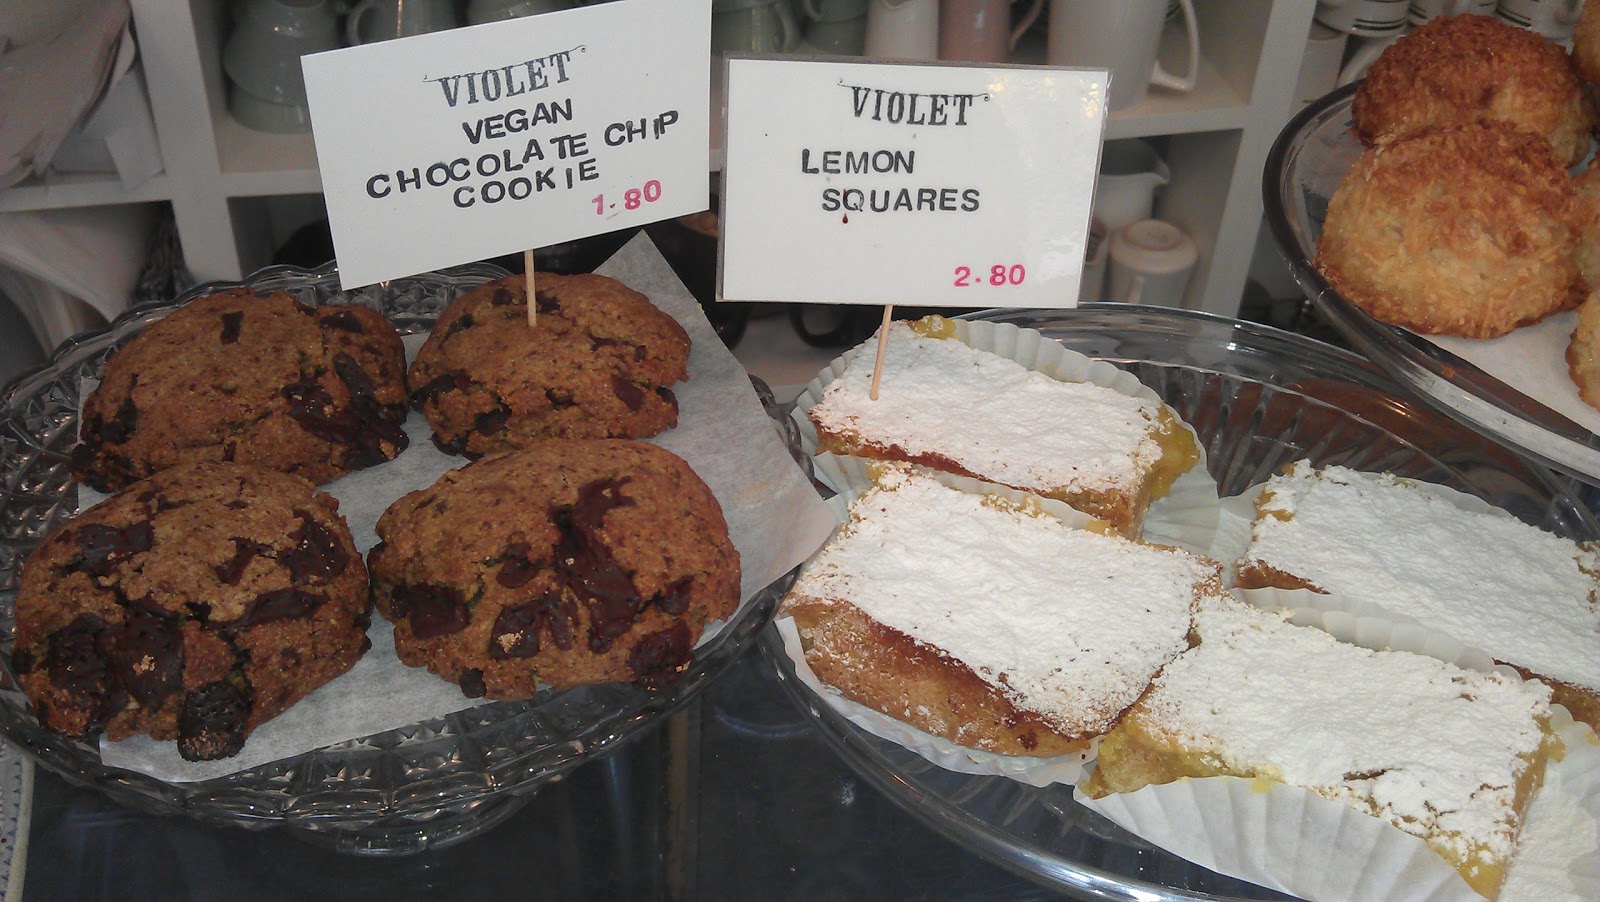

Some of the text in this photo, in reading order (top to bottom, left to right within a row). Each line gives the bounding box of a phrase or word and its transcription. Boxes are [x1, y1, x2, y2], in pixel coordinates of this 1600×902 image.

[438, 50, 572, 107] VIOLET
[462, 98, 573, 144] VEGAN
[850, 86, 973, 126] VIOLET
[366, 110, 680, 198] CHOCOLATE CHIP
[801, 148, 915, 174] LEMON
[453, 158, 600, 208] COOKIE
[821, 188, 980, 212] SQUARES
[954, 264, 1026, 287] 2.80
